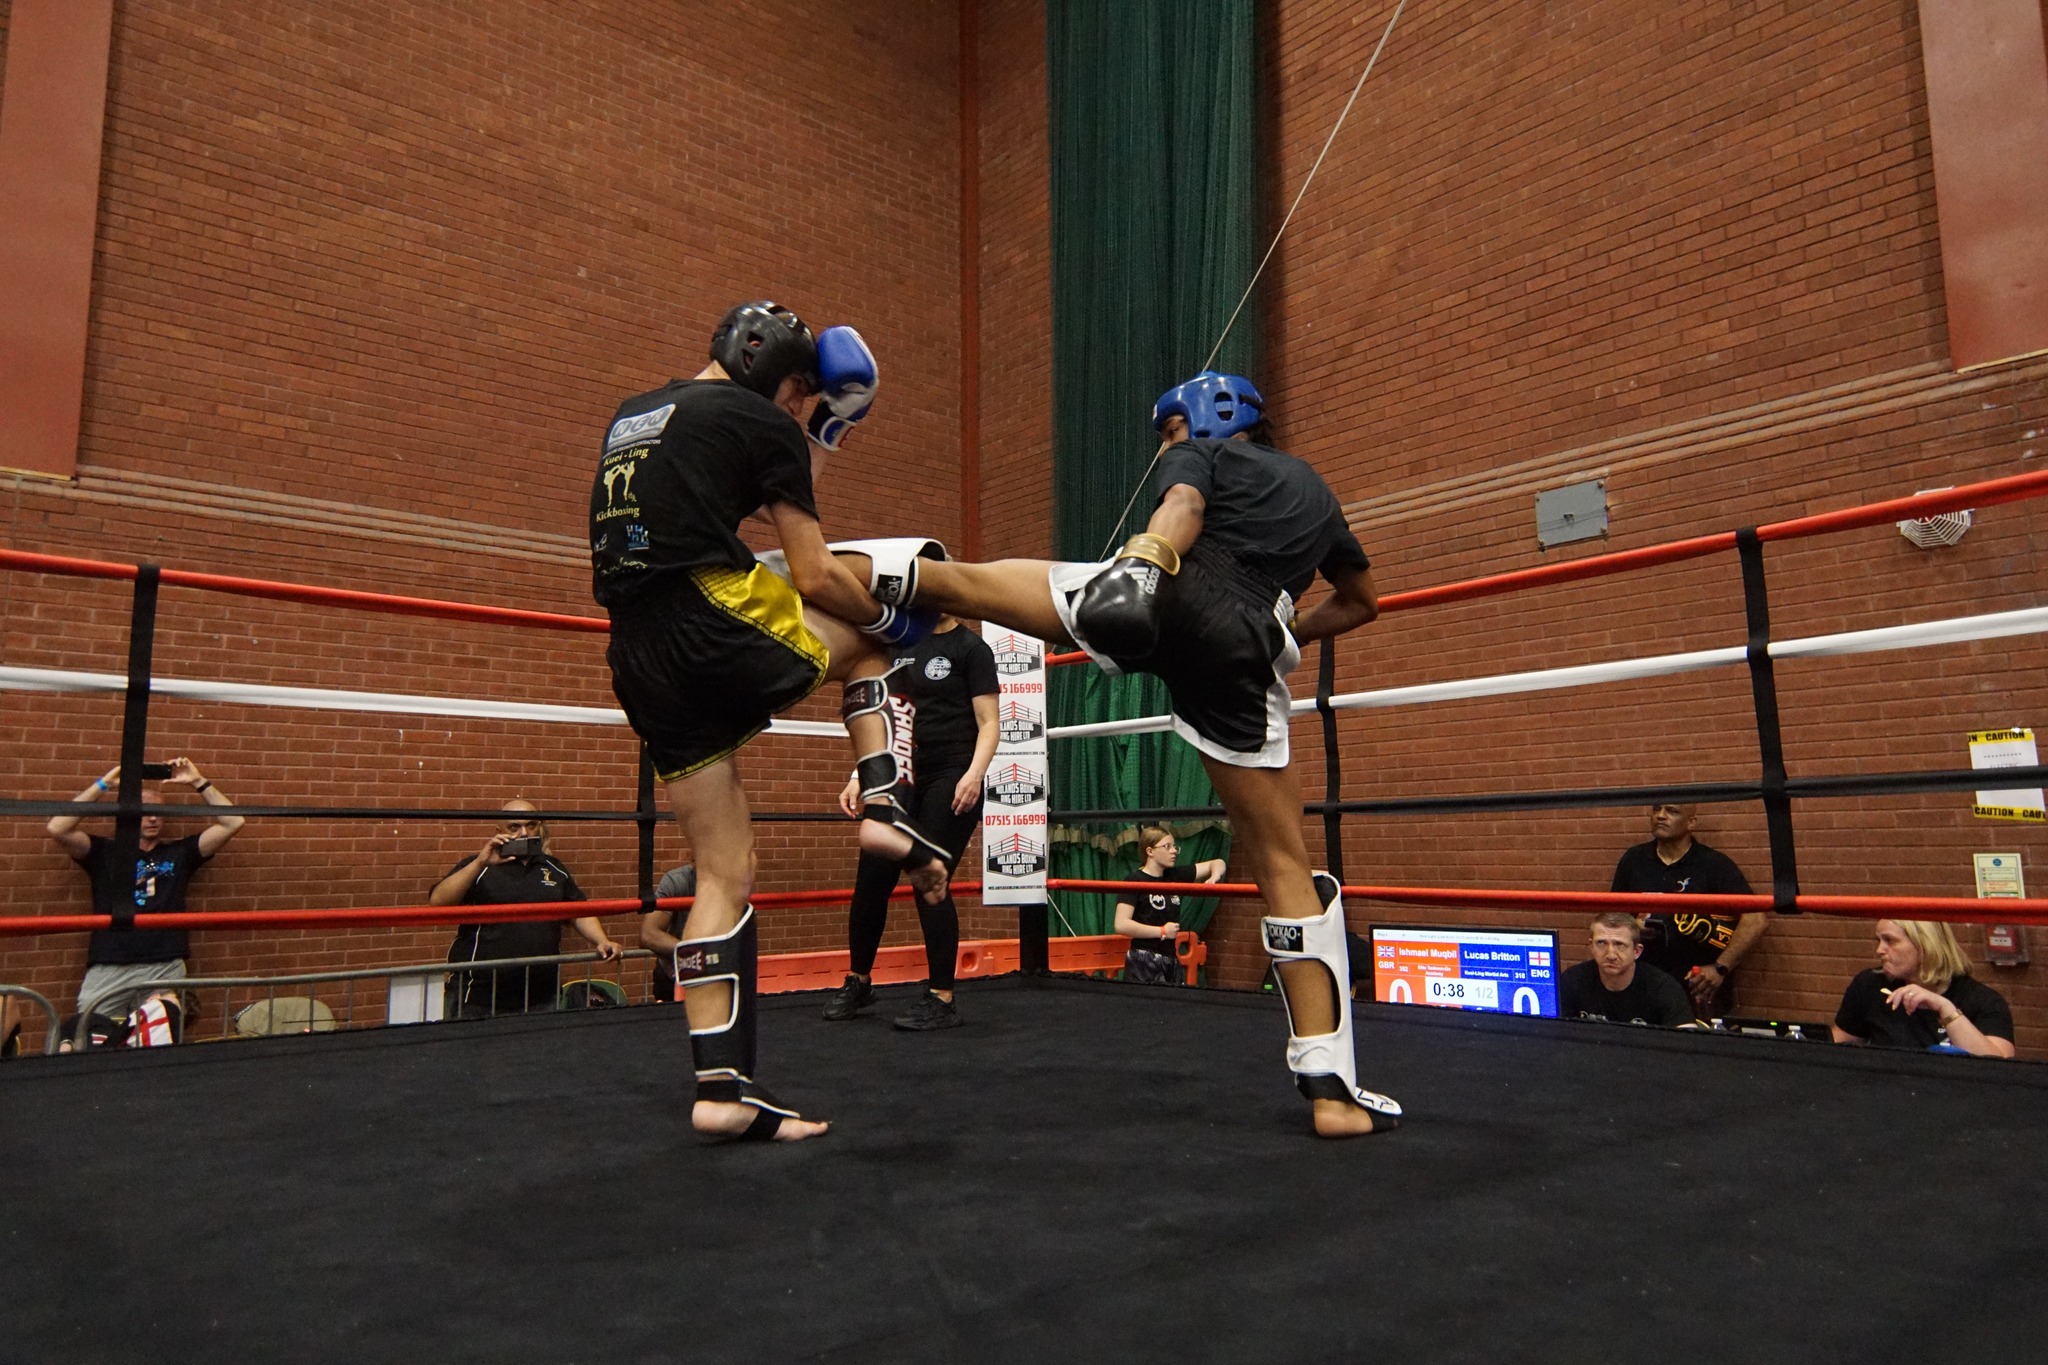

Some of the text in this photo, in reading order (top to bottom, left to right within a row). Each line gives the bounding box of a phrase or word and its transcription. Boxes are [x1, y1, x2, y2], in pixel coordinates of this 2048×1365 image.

[628, 448, 650, 460] Ling
[596, 505, 640, 522] Kickboxing
[1010, 683, 1042, 694] 166999
[888, 695, 916, 785] SANDEE
[1986, 731, 2025, 742] CAUTION
[1000, 794, 1011, 804] RING
[1011, 794, 1025, 804] HIRE
[1974, 806, 2014, 816] CAUTION
[985, 814, 1046, 826] 07515 166999
[1002, 864, 1012, 874] RING
[1012, 864, 1026, 875] HIRE
[1399, 948, 1458, 960] Ishmael Muqbil
[1464, 950, 1520, 962] Lucas Britton
[1378, 961, 1395, 969] GBR
[1530, 969, 1550, 978] ENG
[1433, 982, 1465, 998] 0:38
[1475, 986, 1494, 999] 1/2
